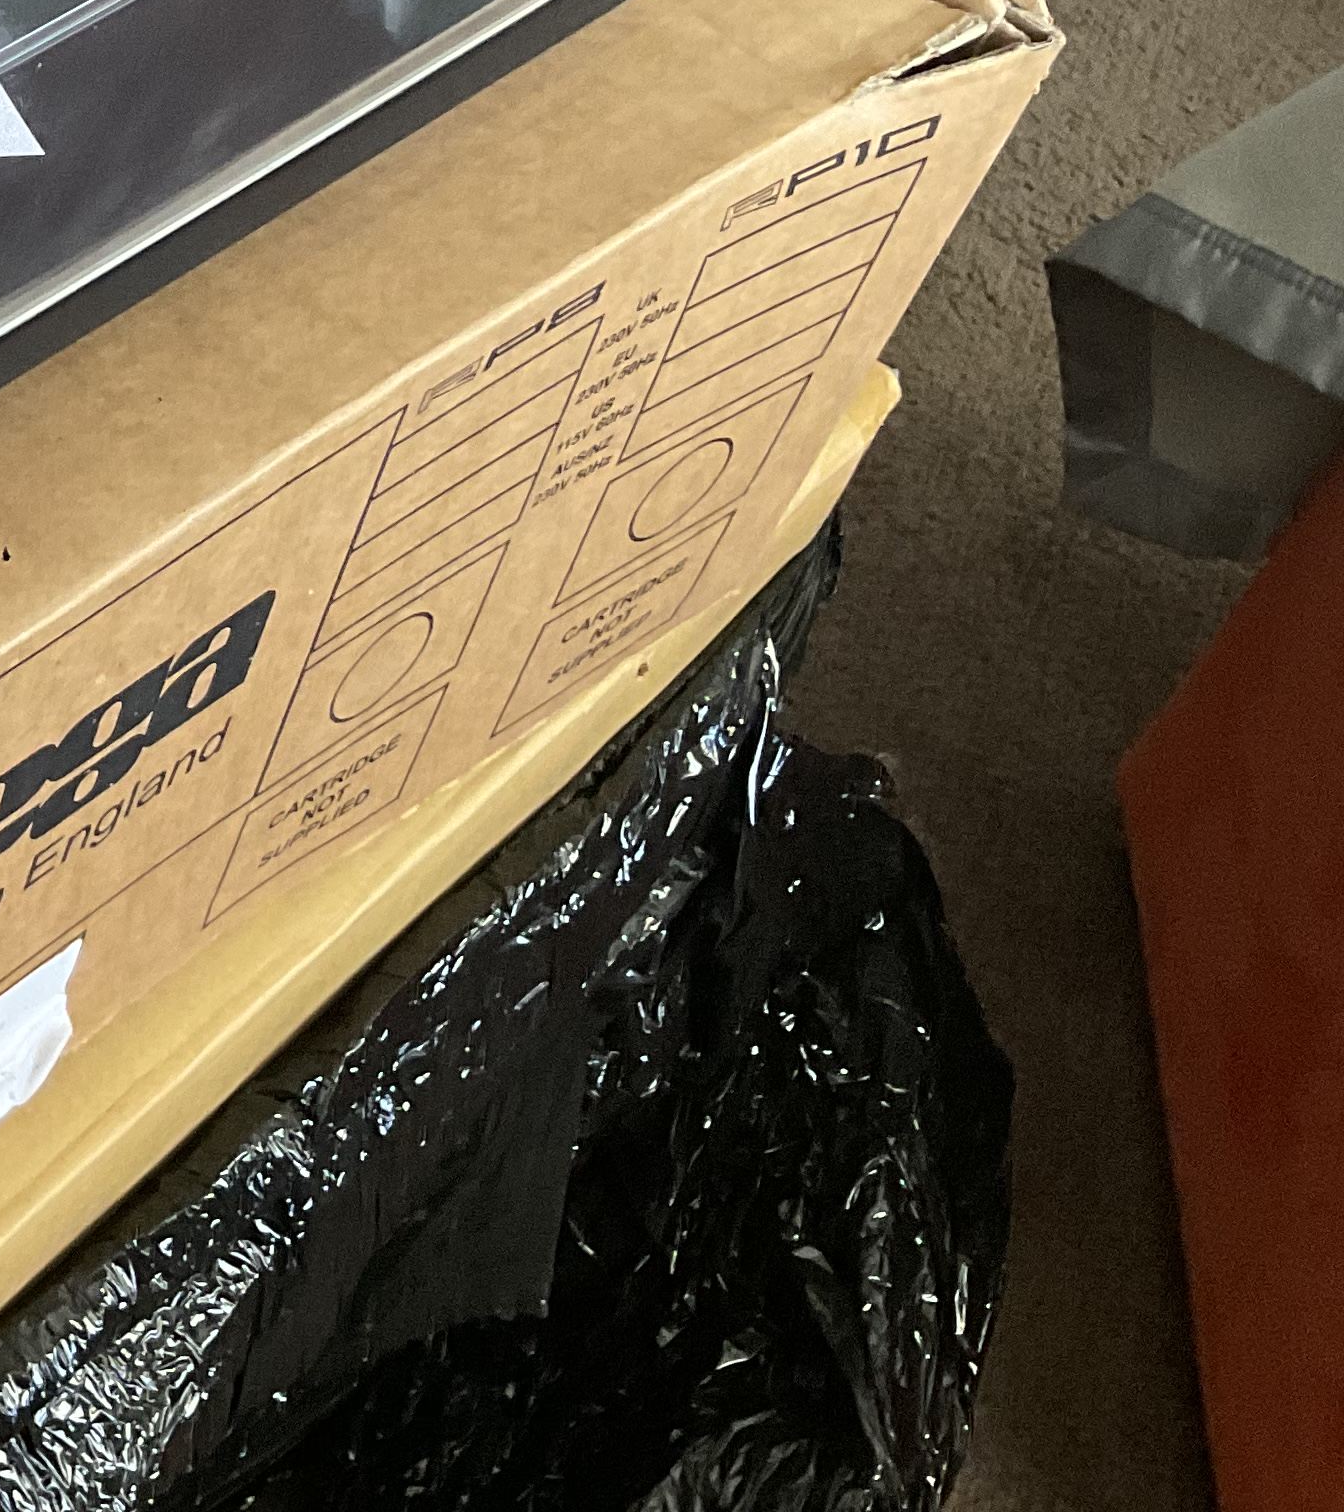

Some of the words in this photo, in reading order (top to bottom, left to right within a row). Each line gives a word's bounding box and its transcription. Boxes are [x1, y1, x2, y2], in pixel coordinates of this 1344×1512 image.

[718, 110, 944, 233] RP10
[636, 287, 661, 312] UK
[613, 344, 637, 368] EU
[591, 397, 615, 421] US
[559, 554, 689, 646] CARTRIDGE
[20, 712, 234, 894] England
[268, 730, 403, 830] CARTRIDGE
[301, 781, 350, 825] NOT
[258, 783, 373, 868] SUPPLIED
